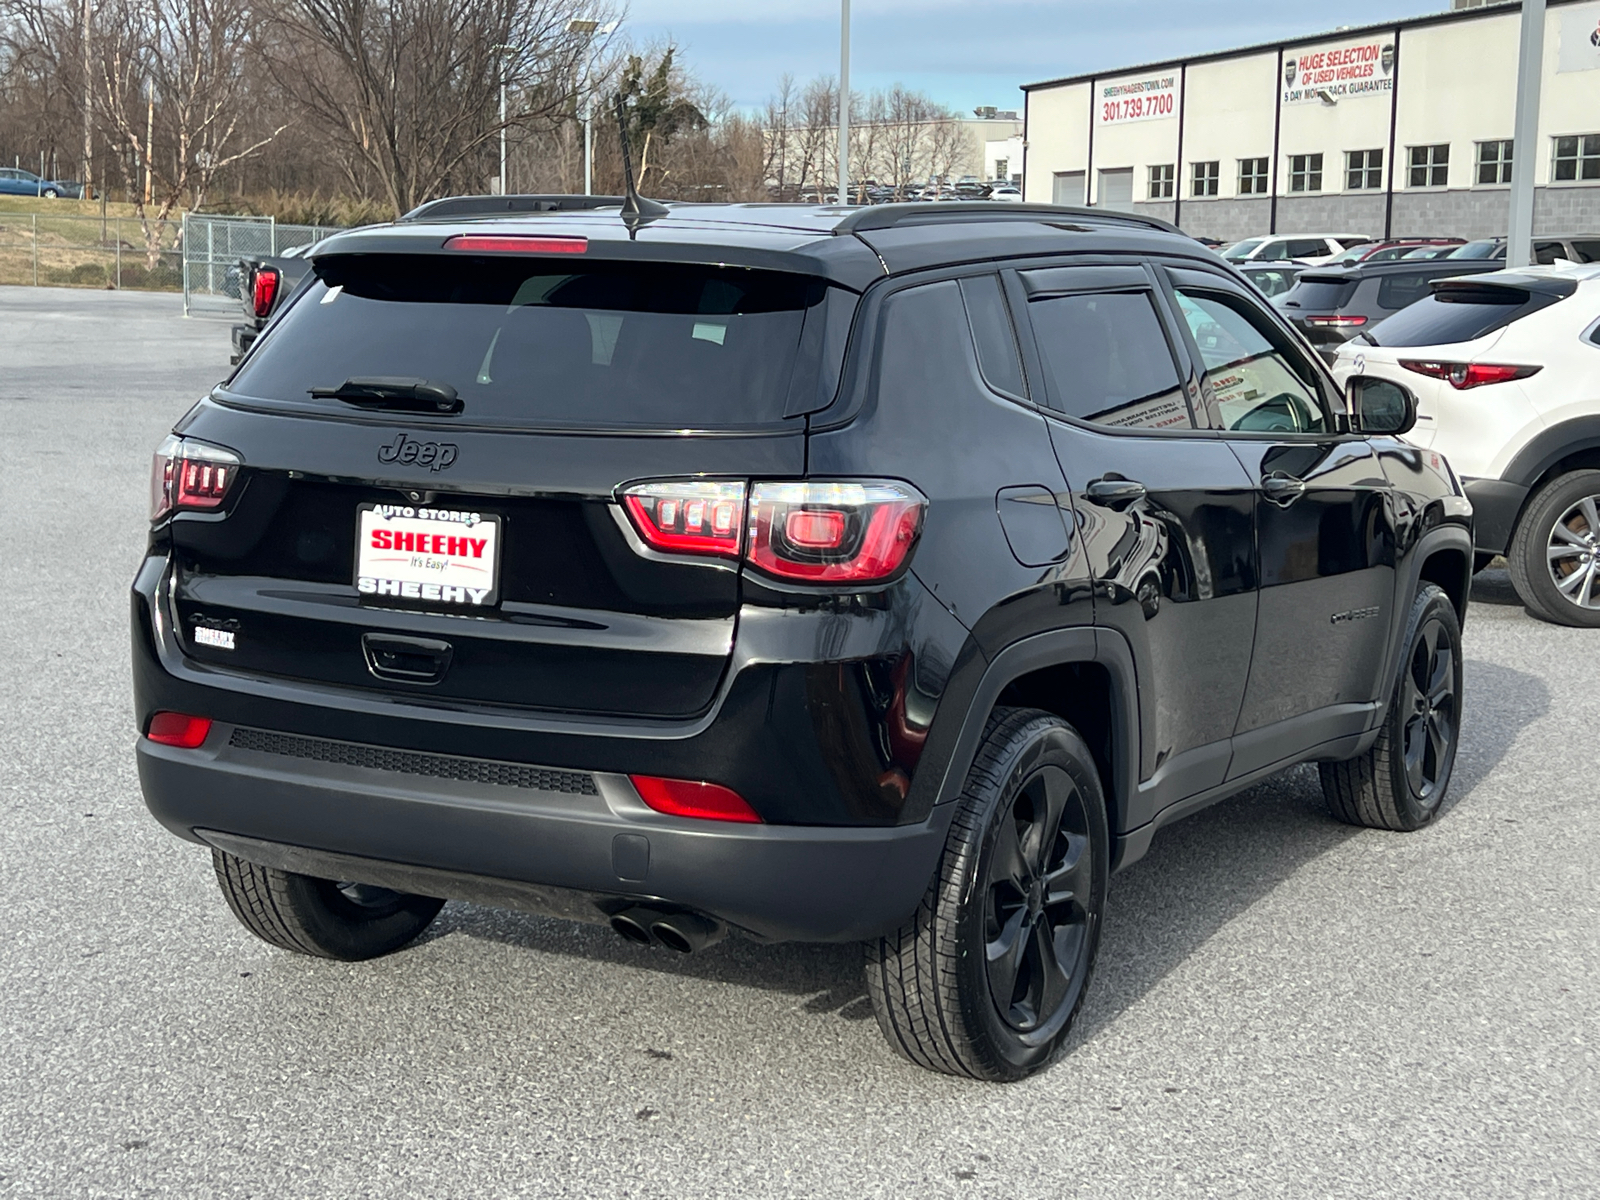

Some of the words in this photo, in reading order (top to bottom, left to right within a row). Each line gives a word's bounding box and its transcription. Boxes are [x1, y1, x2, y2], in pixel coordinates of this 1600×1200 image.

[1298, 53, 1326, 71] HUGE
[1326, 44, 1380, 67] SELECTION
[1302, 72, 1313, 85] OF
[1314, 68, 1335, 84] USED
[1336, 64, 1375, 81] VEHICLES
[1284, 92, 1289, 102] 5
[1290, 90, 1303, 101] DAY
[1349, 78, 1392, 94] GUARANTEE
[1103, 93, 1173, 121] 301.739.7700
[377, 433, 459, 473] Jeep
[373, 504, 414, 518] AUTO
[418, 508, 481, 523] STORES
[371, 529, 488, 559] SHEEHY
[410, 556, 423, 568] It's
[425, 557, 449, 572] Easy!
[357, 577, 491, 605] SHEEHY
